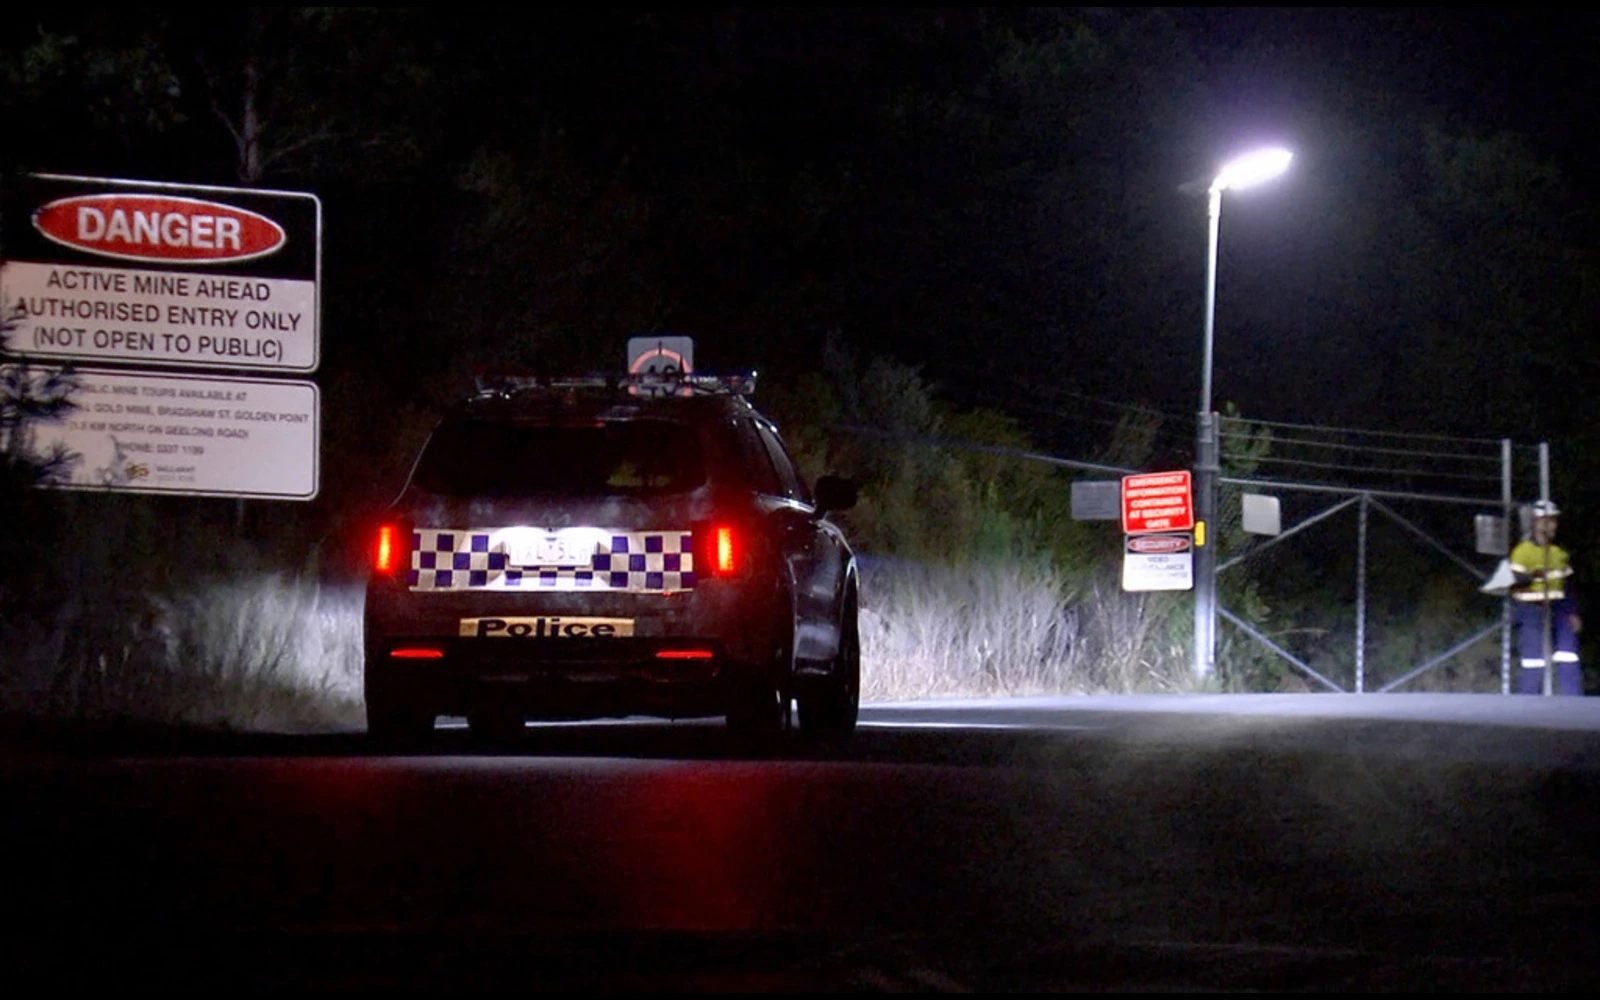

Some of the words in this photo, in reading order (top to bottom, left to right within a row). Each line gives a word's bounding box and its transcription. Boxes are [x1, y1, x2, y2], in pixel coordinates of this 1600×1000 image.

[77, 206, 241, 250] DANGER
[47, 270, 126, 293] ACTIVE
[134, 275, 190, 298] MINE
[195, 279, 271, 301] AHEAD
[15, 296, 160, 323] AUTHORISED
[168, 305, 239, 328] ENTRY
[245, 310, 302, 332] ONLY
[33, 326, 87, 349] (NOT
[93, 329, 155, 351] OPEN
[163, 333, 191, 354] TO
[198, 335, 284, 363] PUBLIC)
[178, 389, 233, 401] AVAILABLE
[235, 391, 248, 401] AT
[94, 403, 125, 413] GOLD
[234, 410, 277, 422] GOLDEN
[279, 412, 310, 423] POINT
[108, 422, 145, 433] NORTH
[147, 424, 163, 434] ON
[165, 425, 214, 438] GEELONG
[477, 617, 616, 638] Police
